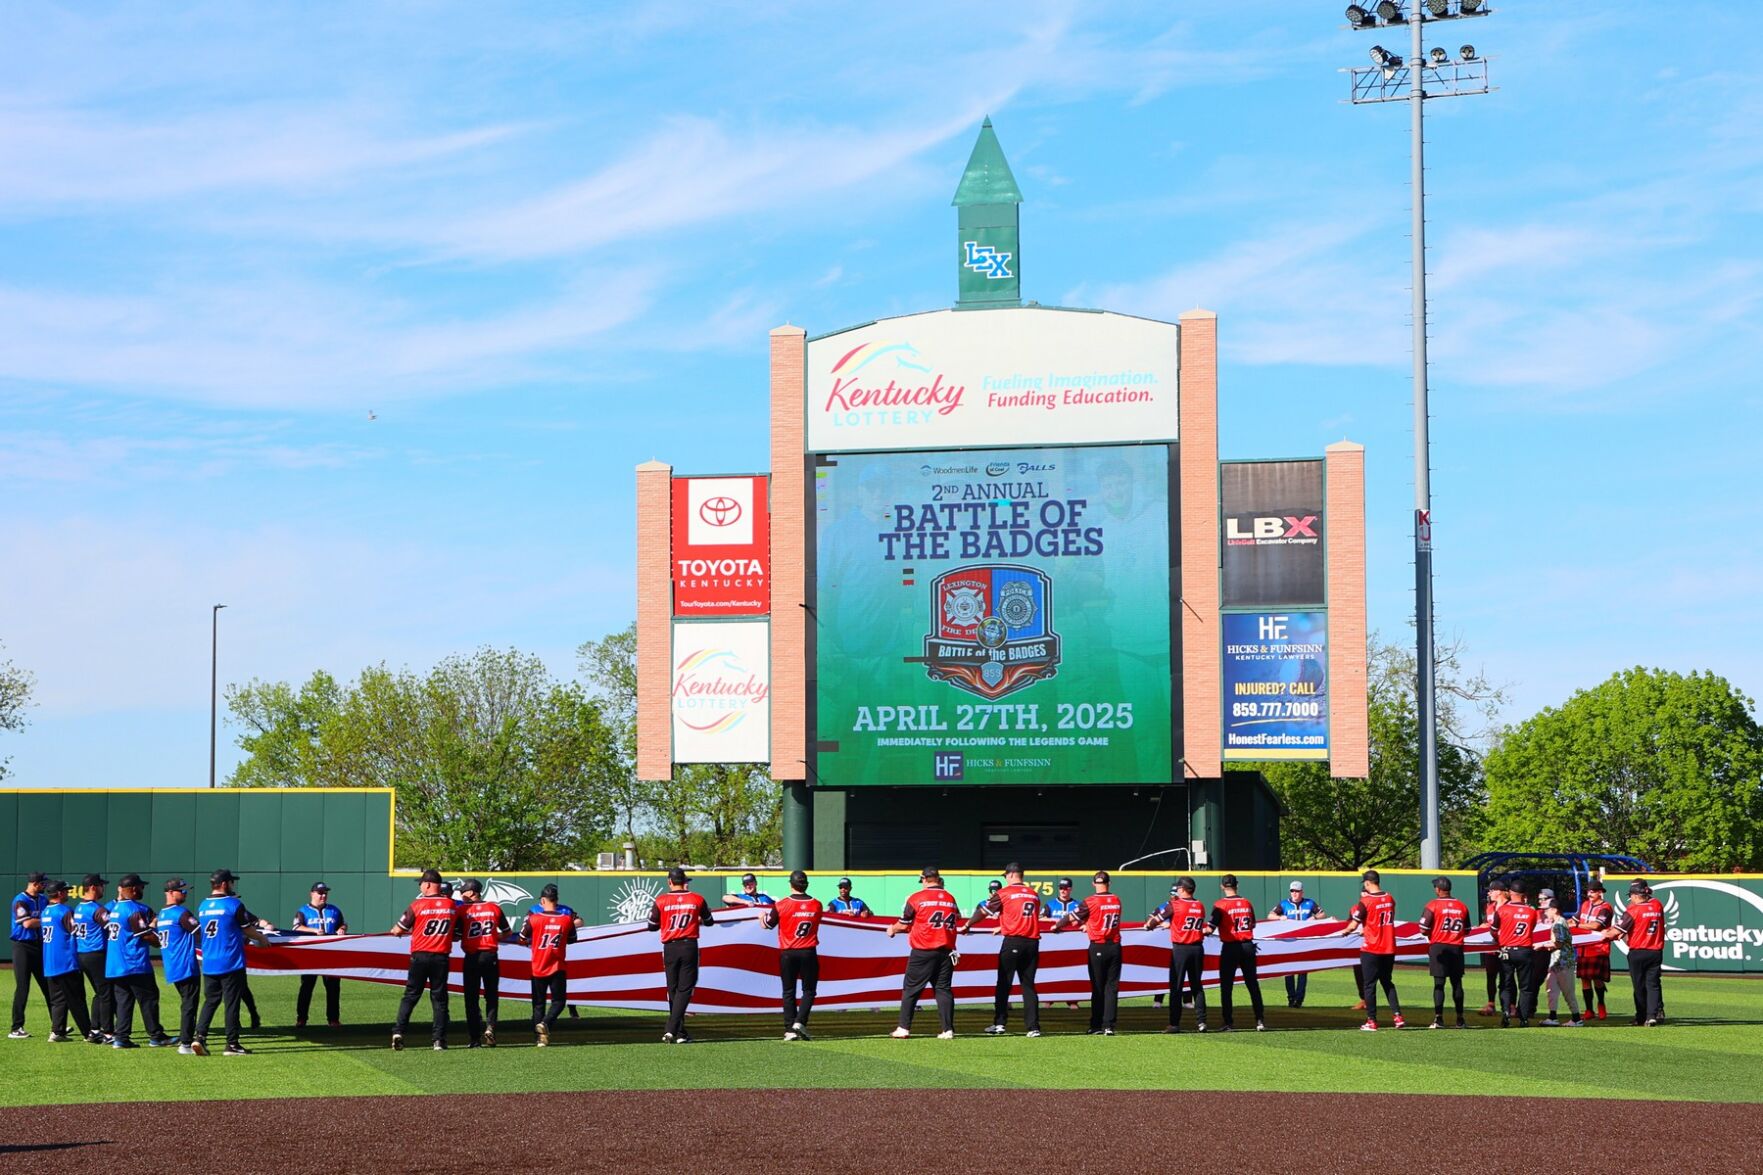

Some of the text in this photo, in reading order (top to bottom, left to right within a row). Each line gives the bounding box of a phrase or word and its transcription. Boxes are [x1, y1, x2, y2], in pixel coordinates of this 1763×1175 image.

[964, 241, 1014, 278] LEX
[982, 370, 1158, 391] Fueling Imagination.
[825, 374, 965, 416] Kentucky
[988, 387, 1154, 410] Funding Education.
[833, 410, 934, 427] LOTTERY
[962, 482, 1049, 500] ANNUAL
[894, 500, 1087, 532] BATTLE OF
[1226, 515, 1319, 539] LBX
[878, 528, 1105, 560] THE BADGES
[678, 559, 764, 577] TOYOTA
[680, 579, 763, 588] KENTUCKY
[942, 580, 988, 592] LEXINGTON
[1008, 643, 1047, 661] BADGES
[1227, 644, 1323, 654] HICKS & FUNFSINN
[671, 672, 769, 704] Kentucky
[1235, 682, 1316, 695] INJURED? CALL
[677, 697, 748, 709] LOTTERY
[1233, 702, 1319, 717] 859.777.7000
[853, 703, 1134, 733] APRIL 27TH, 2025
[877, 736, 1109, 746] IMMEDIATELY FOLLOWING THE LEGENDS GAME
[1229, 733, 1325, 746] HonestFearless.com
[966, 759, 994, 767] HICKS
[204, 919, 219, 939] 4
[422, 919, 451, 937] 80
[669, 913, 692, 931] 10
[928, 910, 956, 930] 44
[467, 920, 494, 939] 22
[794, 921, 812, 939] 8
[1664, 925, 1763, 946] entucky
[539, 933, 563, 949] 14
[1673, 942, 1752, 960] Proud.
